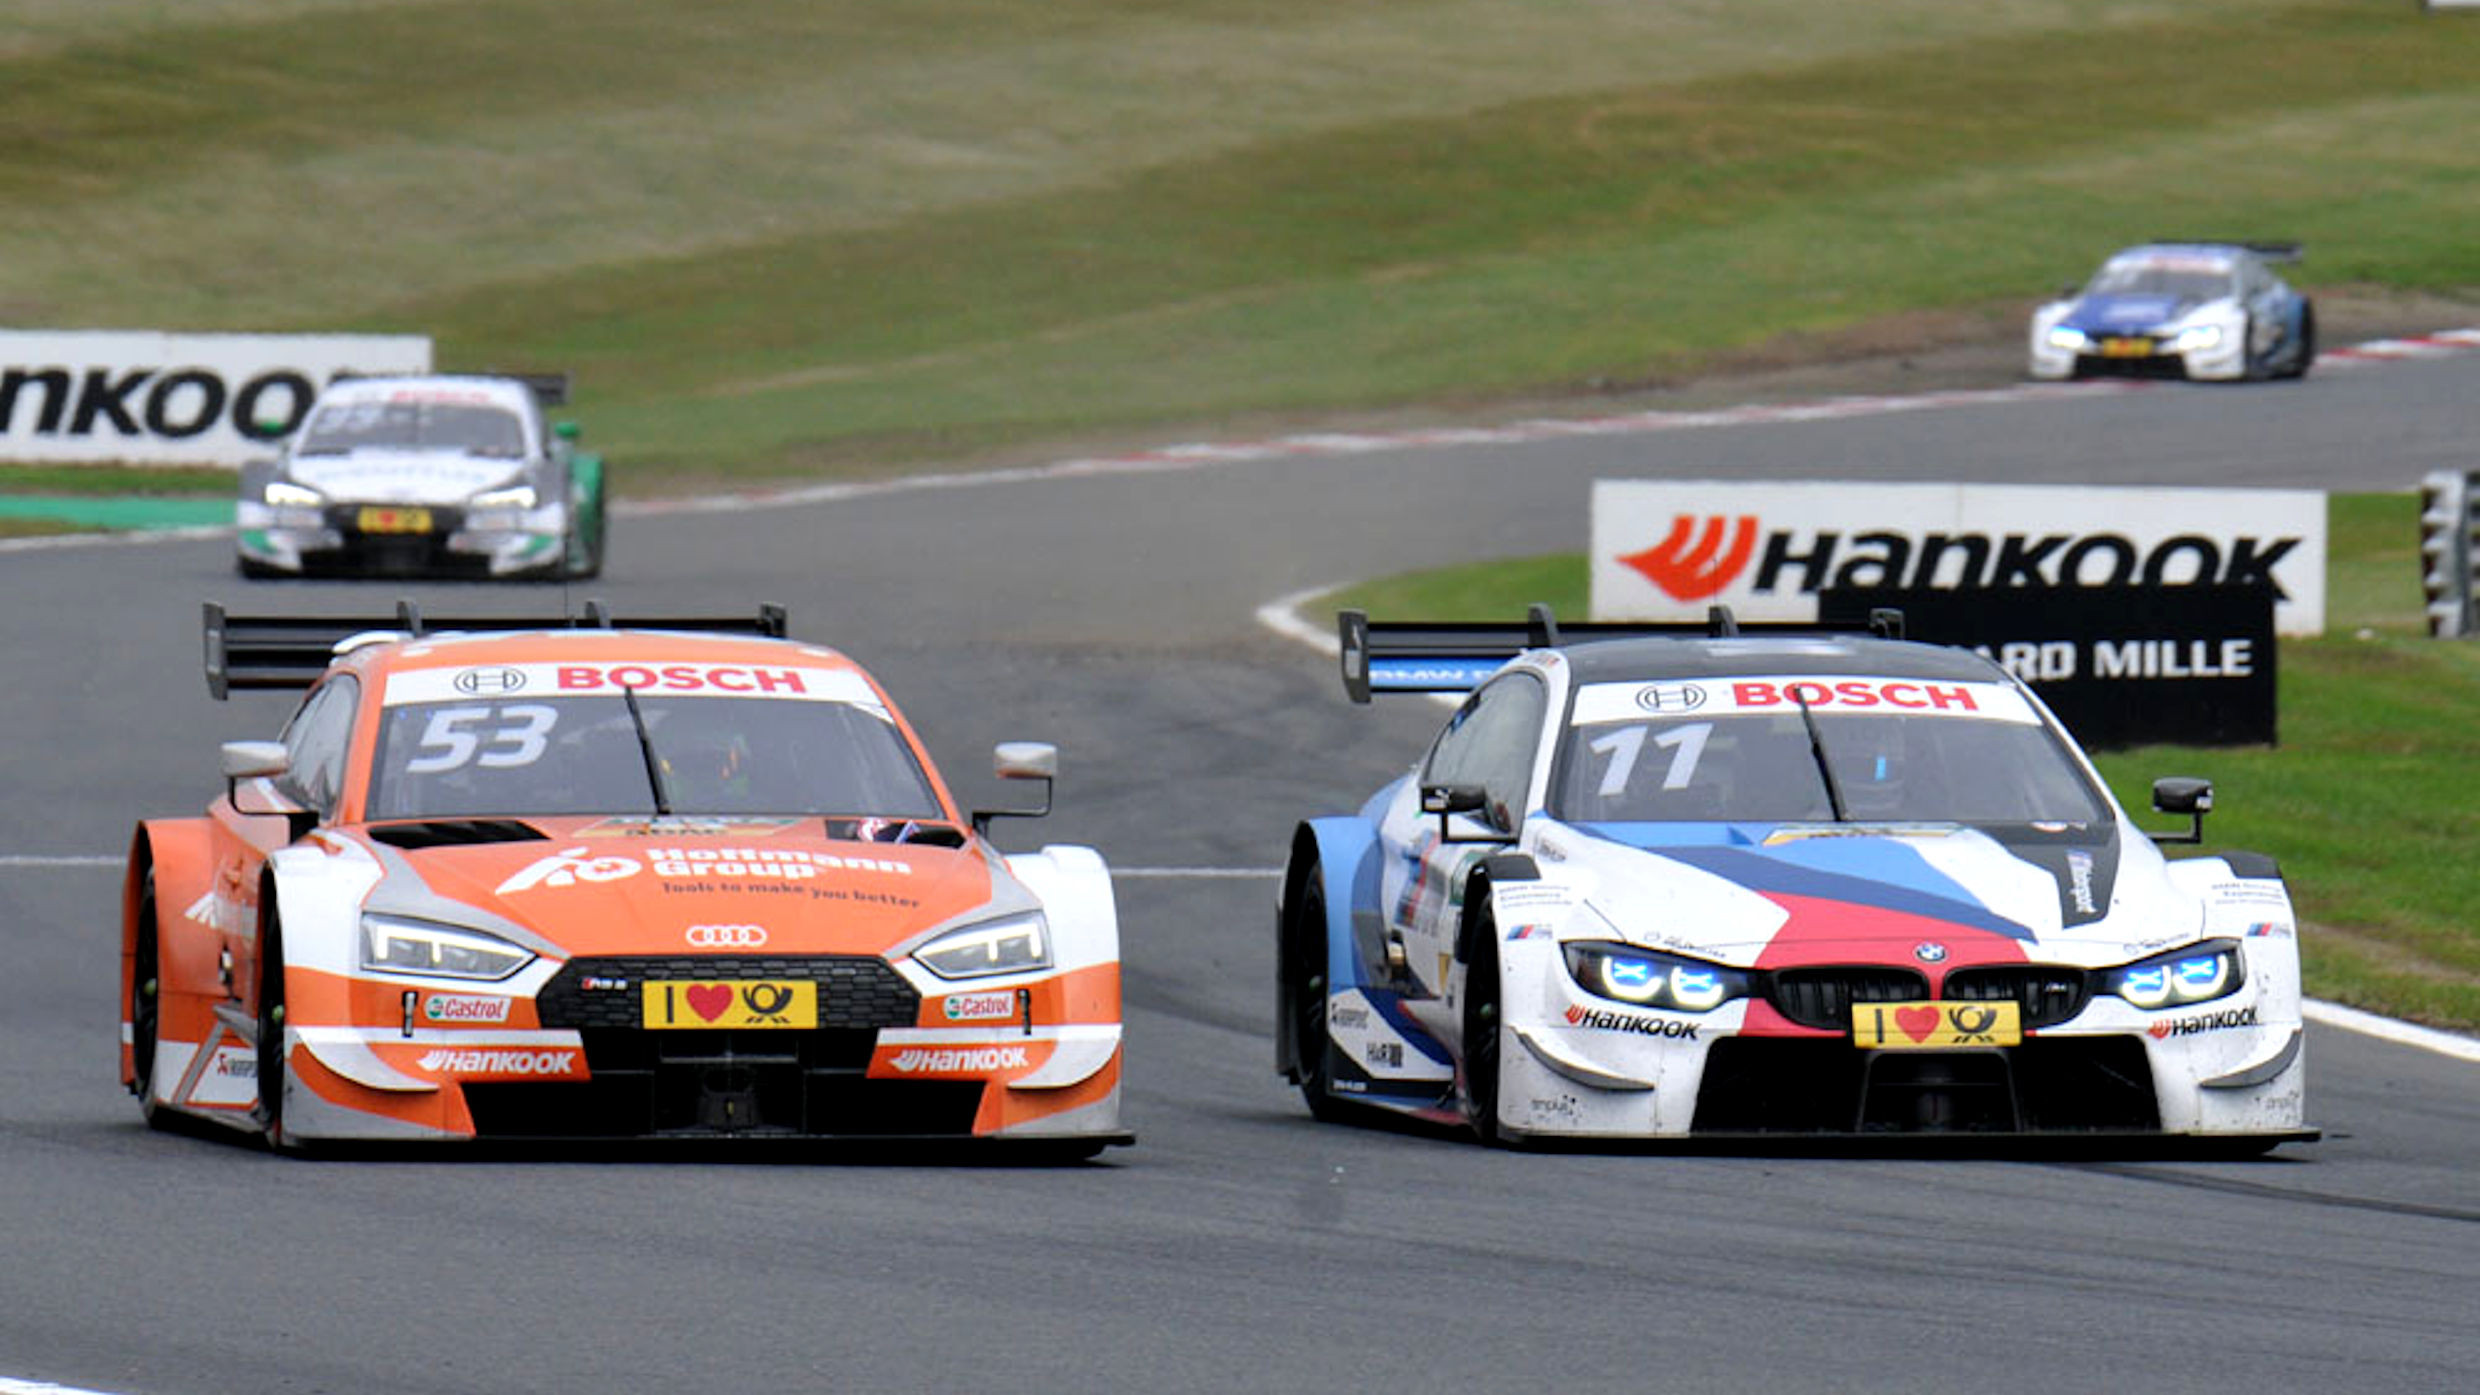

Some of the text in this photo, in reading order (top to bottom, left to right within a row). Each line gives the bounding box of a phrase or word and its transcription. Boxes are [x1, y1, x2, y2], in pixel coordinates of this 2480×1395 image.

[0, 364, 345, 442] nKOO
[2093, 639, 2253, 678] MILLE
[557, 665, 808, 694] BOSCH
[1731, 681, 1980, 711] BOSCH
[406, 704, 559, 774] 53
[1590, 722, 1714, 797] 11
[646, 848, 913, 875] Hoffmann
[654, 860, 817, 880] Group
[661, 881, 921, 908] Tools to make you better
[444, 998, 504, 1019] Castrol
[664, 985, 675, 1024] I
[960, 995, 1010, 1016] Castrol
[1874, 1007, 1886, 1044] I
